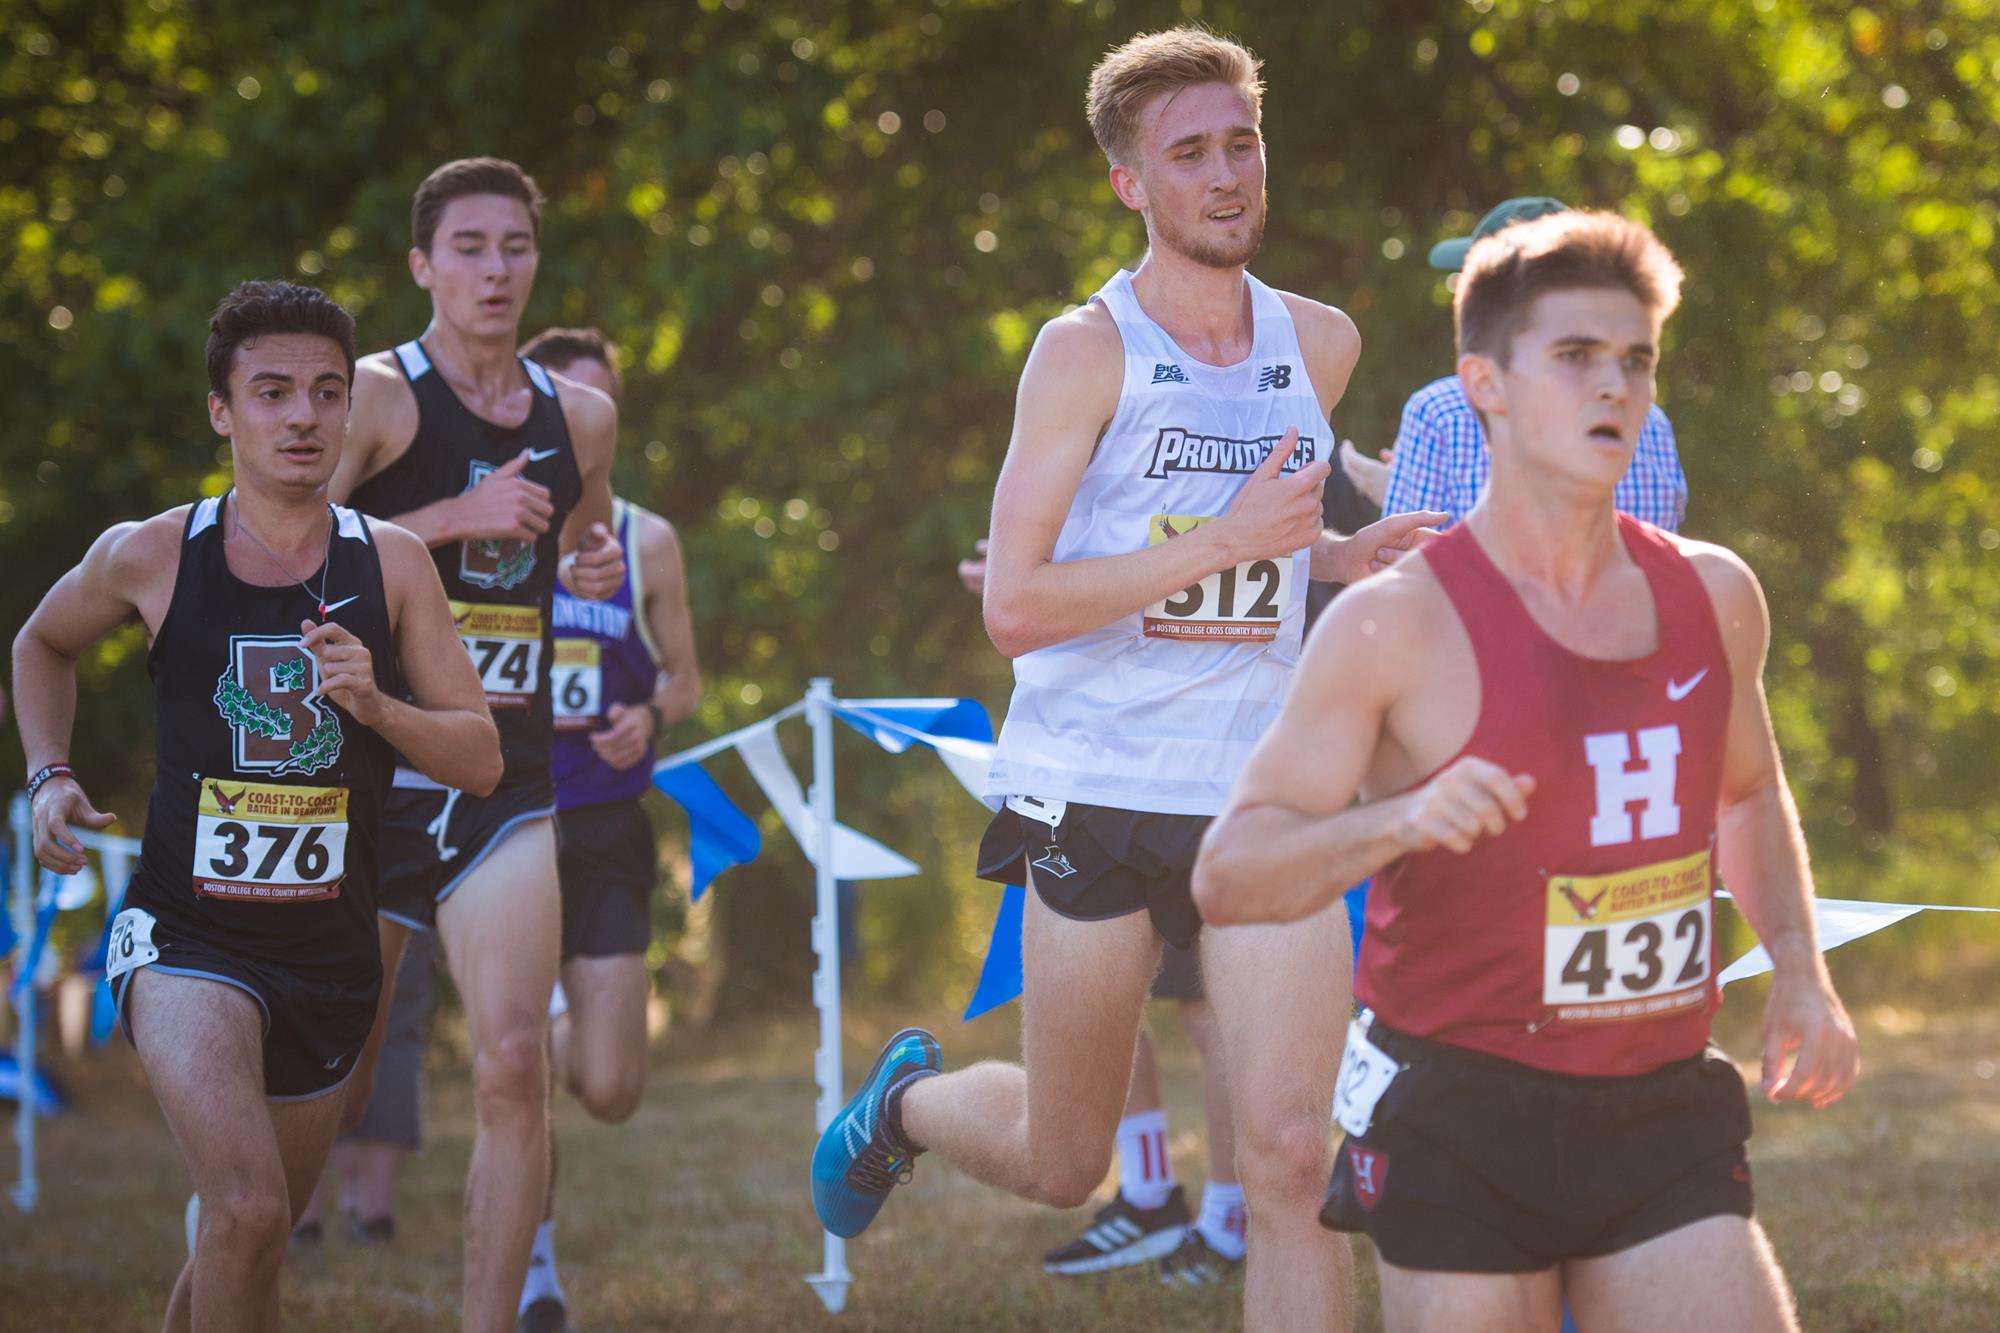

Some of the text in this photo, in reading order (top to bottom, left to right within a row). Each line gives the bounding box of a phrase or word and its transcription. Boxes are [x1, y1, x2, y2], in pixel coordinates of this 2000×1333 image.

[1155, 363, 1181, 373] BIG
[1153, 373, 1189, 381] EAS
[1157, 624, 1180, 634] BOSTON
[1181, 625, 1205, 635] COLLEGE
[1206, 626, 1224, 635] CROSS
[1224, 626, 1250, 635] COUNTRY
[463, 640, 531, 690] 74
[562, 670, 588, 710] 6
[1583, 724, 1682, 847] H
[248, 792, 339, 807] COAST-TO-COAST
[247, 803, 337, 816] BATTLE IN BEANTOWN
[209, 821, 330, 881] 376
[203, 883, 226, 893] BOSTON
[226, 885, 251, 895] COLLEGE
[252, 887, 271, 896] CROSS
[271, 888, 297, 897] COUNTRY
[1561, 909, 1705, 997] 432
